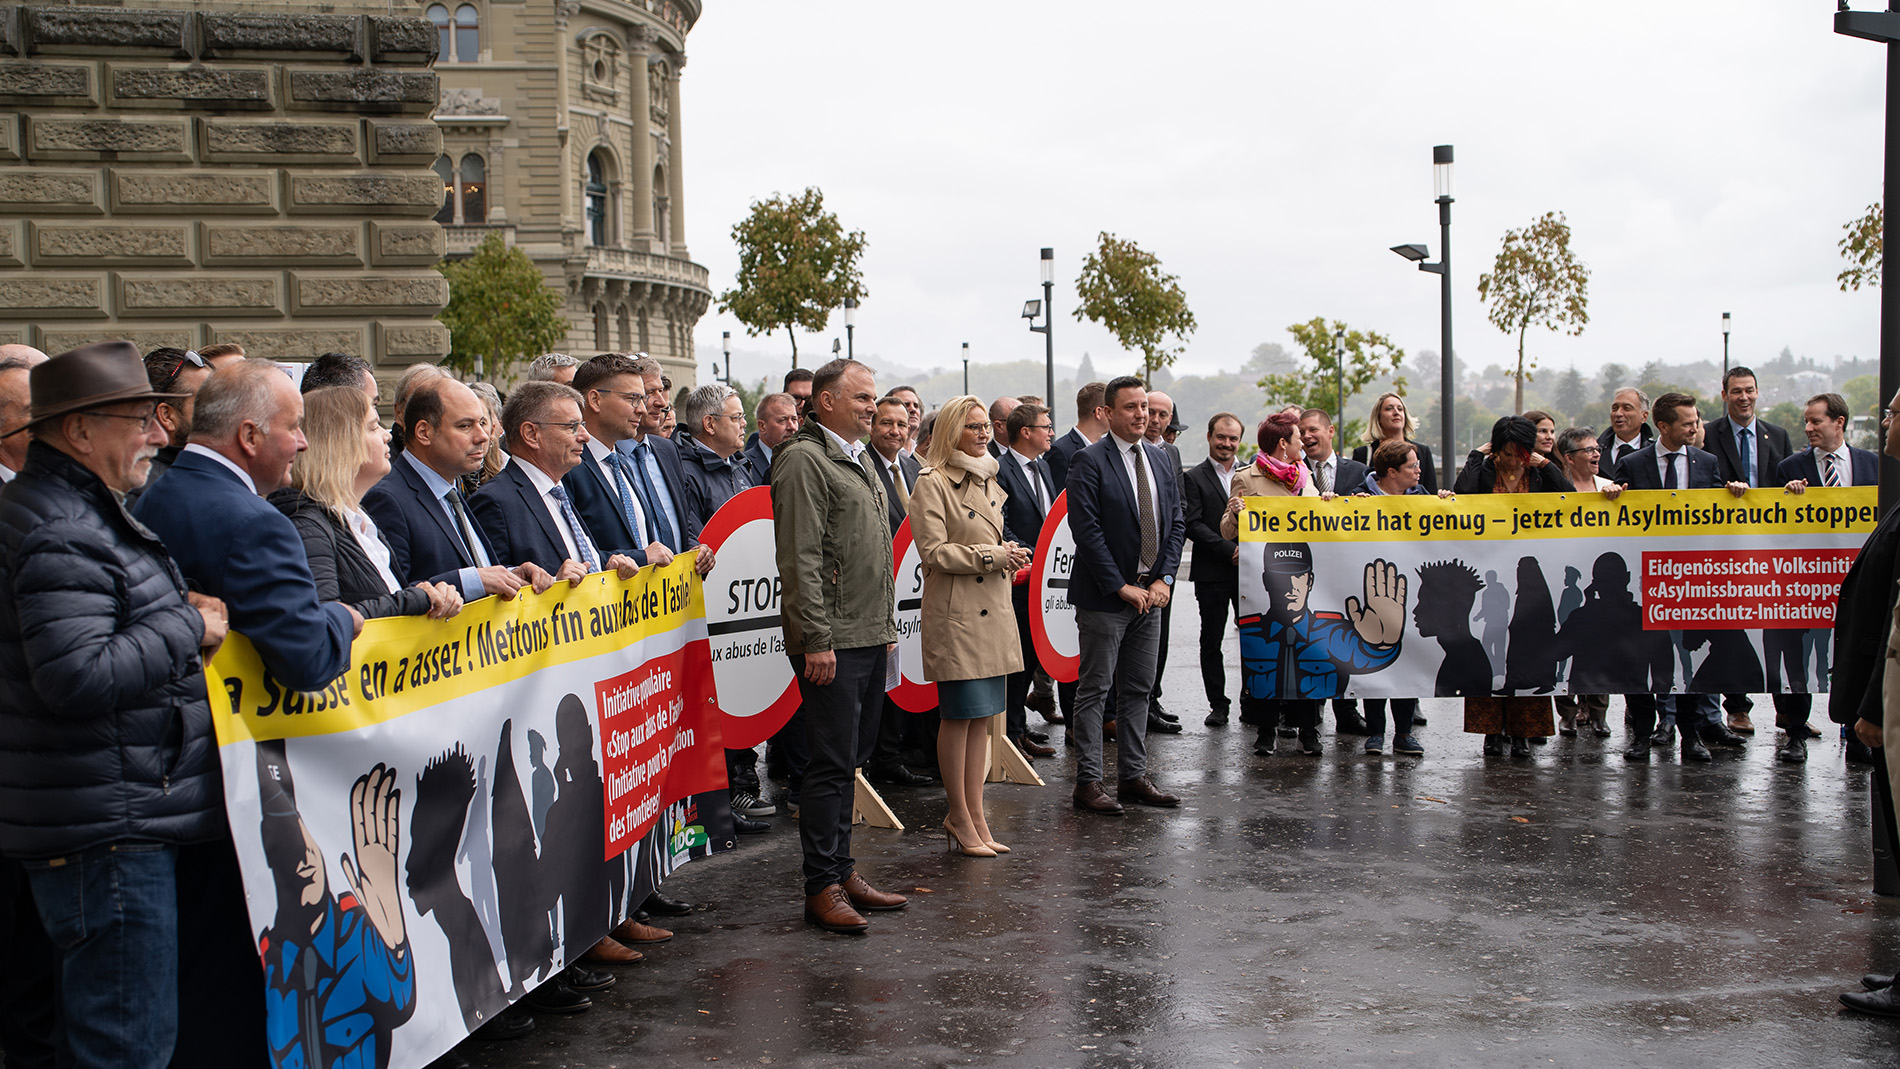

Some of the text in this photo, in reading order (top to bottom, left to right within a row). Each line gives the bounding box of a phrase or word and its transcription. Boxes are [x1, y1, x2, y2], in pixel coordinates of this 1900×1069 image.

[1248, 510, 1280, 532] Die
[1286, 509, 1371, 533] Schweiz
[1377, 509, 1412, 532] hat
[1418, 512, 1486, 536] genug
[1511, 507, 1564, 535] jetzt
[1570, 505, 1611, 528] den
[1616, 502, 1788, 532] Asylmissbrauch
[1053, 546, 1075, 574] Fer
[1274, 549, 1303, 559] POLIZEI
[1648, 556, 1854, 580] Eidgenössische Volksiniti
[727, 576, 782, 615] STOP
[1648, 580, 1841, 602] «Asylmissbrauch stoppe
[1648, 601, 1837, 624] (Grenzschutz-Initiative)
[224, 676, 243, 715] a
[360, 660, 389, 701] en
[393, 656, 409, 694] a
[410, 640, 463, 689] assez
[477, 616, 549, 669] Mettons
[551, 602, 584, 646] fin
[589, 602, 619, 637] aux
[641, 582, 659, 621] de
[725, 641, 752, 661] abus
[753, 637, 767, 656] de
[602, 680, 640, 719] Initiative
[630, 723, 646, 749] aux
[656, 704, 668, 731] de
[608, 759, 646, 807] (Initiative
[646, 751, 661, 787] pour
[658, 743, 668, 769] la
[609, 813, 626, 843] des
